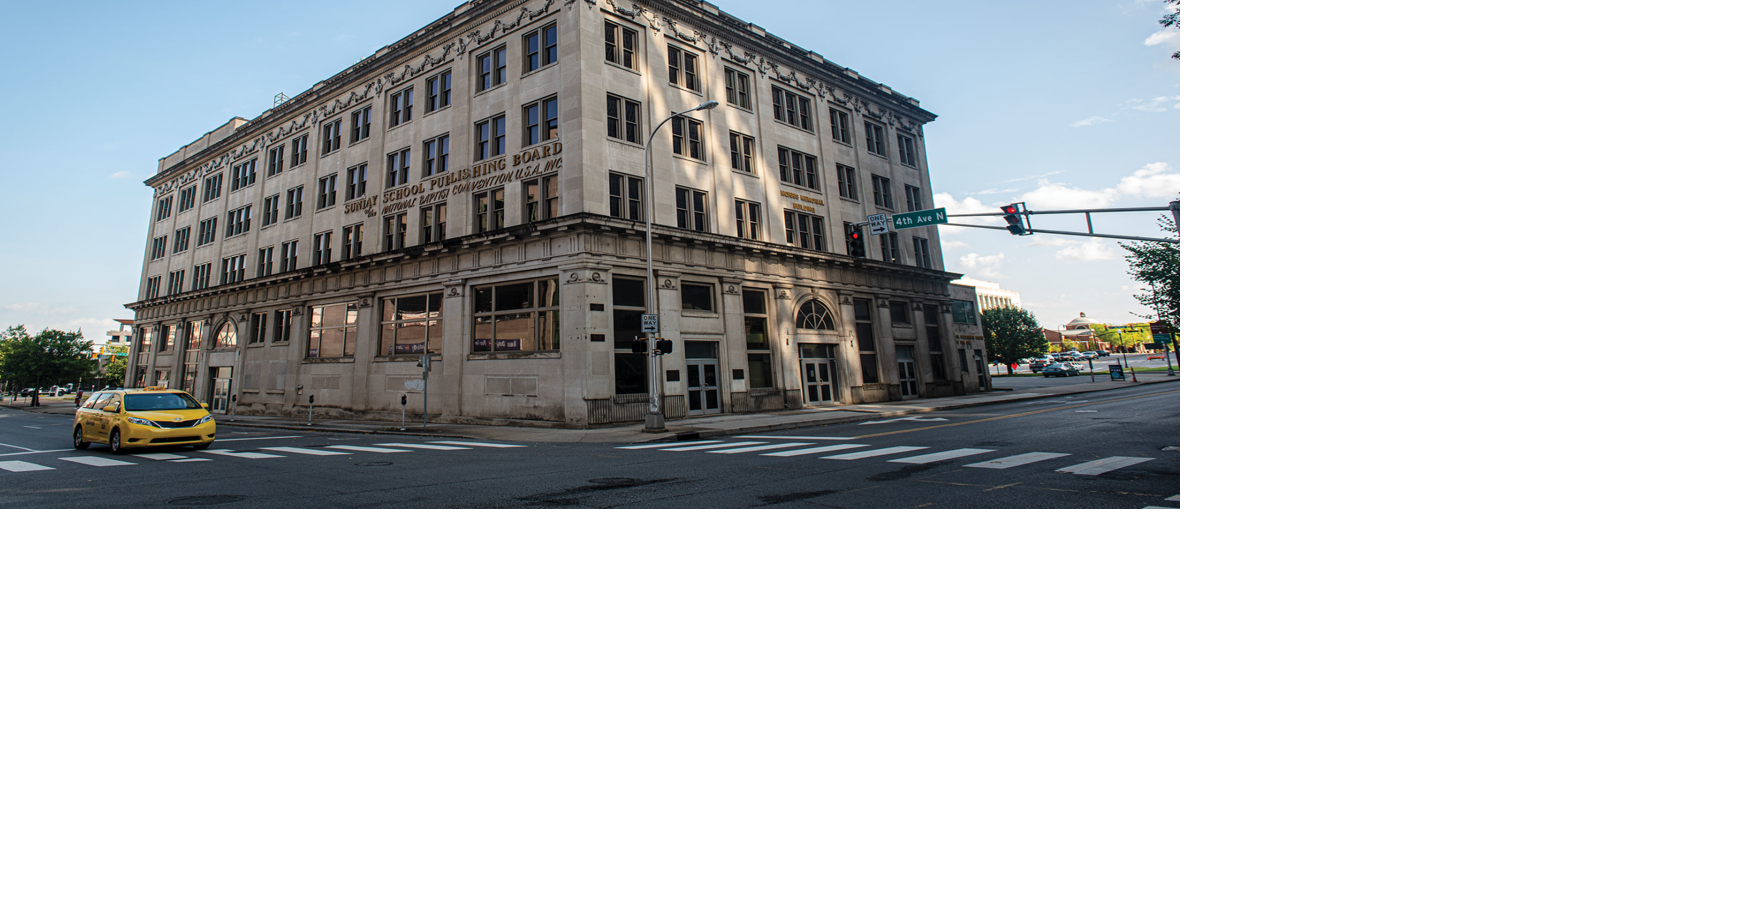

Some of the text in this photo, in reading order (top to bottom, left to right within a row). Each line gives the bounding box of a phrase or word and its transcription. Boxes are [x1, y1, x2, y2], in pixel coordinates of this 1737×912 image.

[382, 183, 425, 204] SCHOOL
[430, 158, 506, 191] PUBLISHING
[512, 142, 563, 167] BOARD
[381, 198, 417, 215] NATIONAL
[419, 188, 450, 205] BAPTIST
[869, 214, 884, 222] ONE
[871, 220, 885, 228] WAY
[896, 211, 945, 226] 4th Ave N
